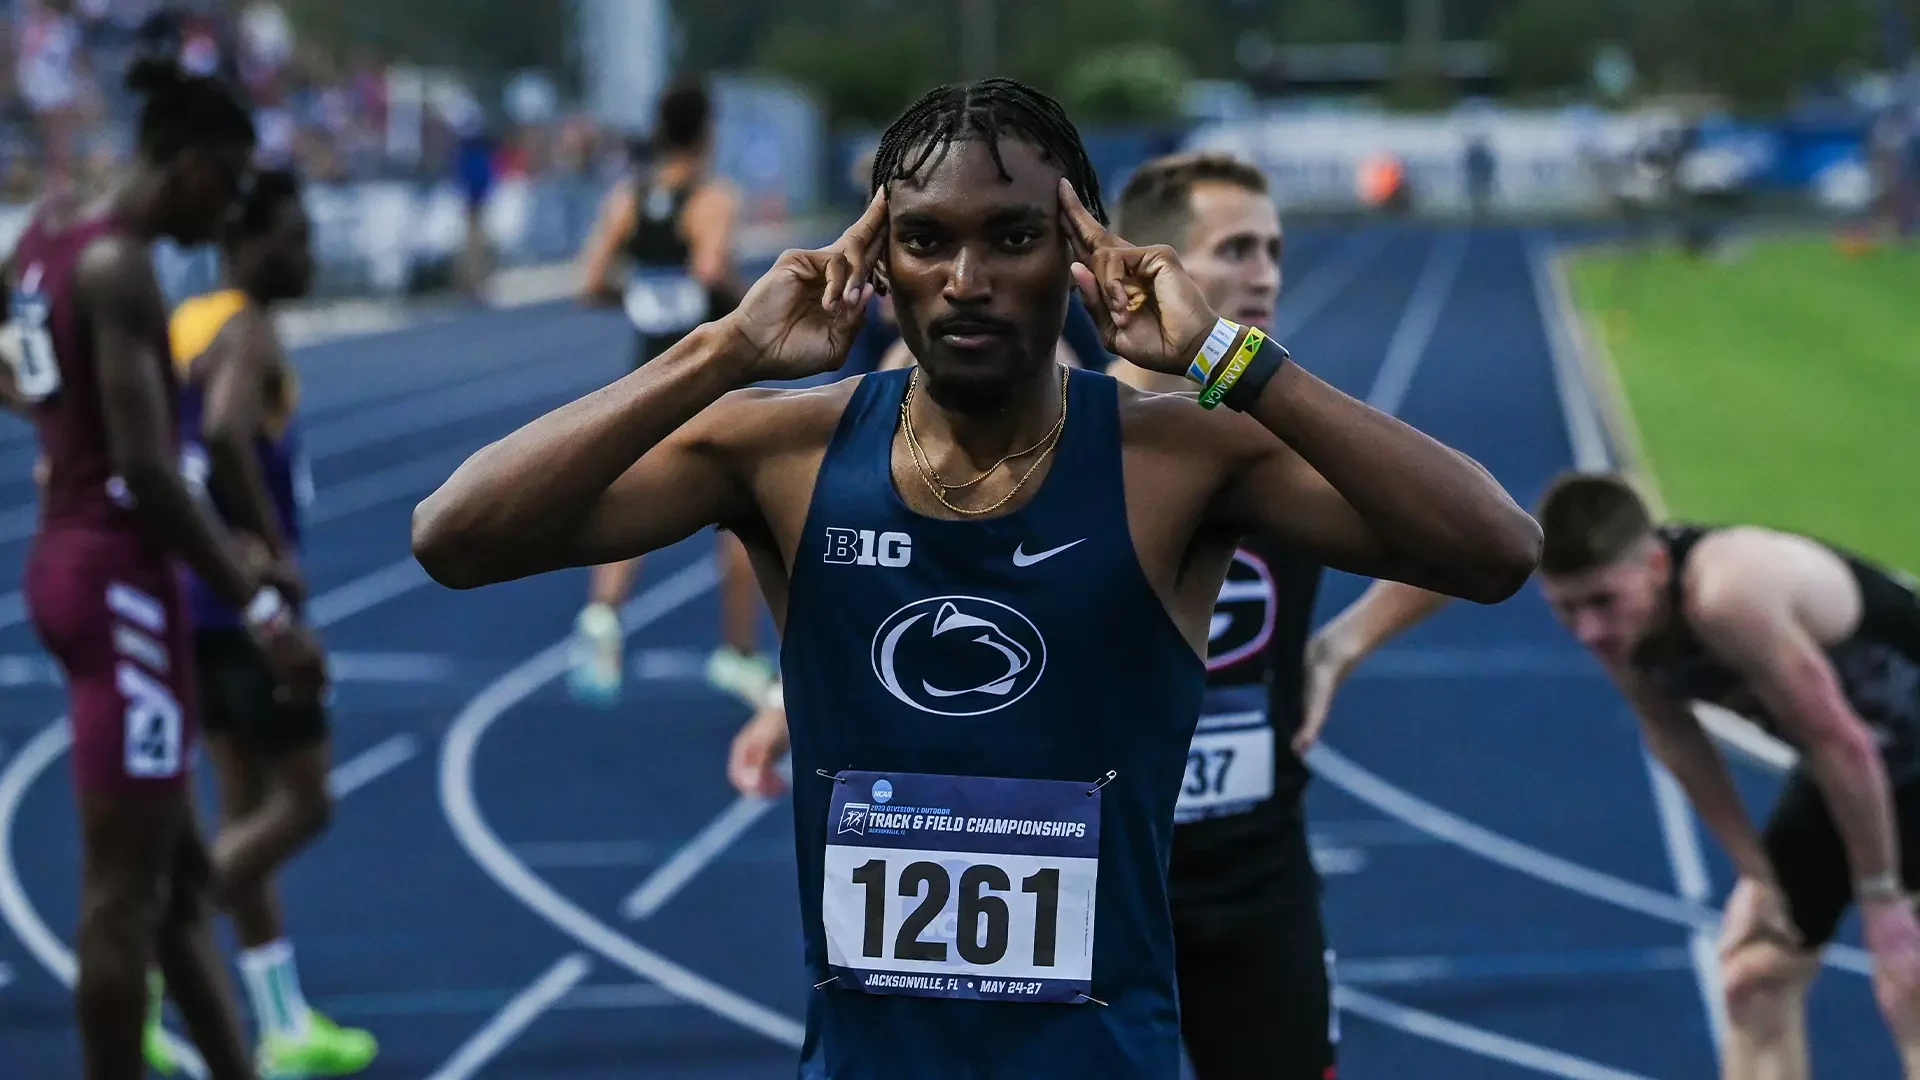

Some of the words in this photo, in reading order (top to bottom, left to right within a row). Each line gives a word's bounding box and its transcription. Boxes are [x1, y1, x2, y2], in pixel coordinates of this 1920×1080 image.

[1205, 355, 1246, 404] JAMAICA
[873, 790, 893, 798] NCAA
[870, 804, 886, 812] 2023
[886, 805, 915, 813] DIVISION
[920, 807, 951, 815] OUTDOOR
[869, 812, 912, 829] TRACK
[912, 814, 924, 829] &
[924, 815, 964, 832] FIELD
[966, 817, 1086, 838] CHAMPIONSHIPS
[852, 858, 1060, 967] 1261
[865, 973, 944, 991] JACKSONVILLE,
[947, 978, 959, 991] FL
[980, 980, 1005, 994] MAY
[1007, 981, 1042, 995] 24-27
